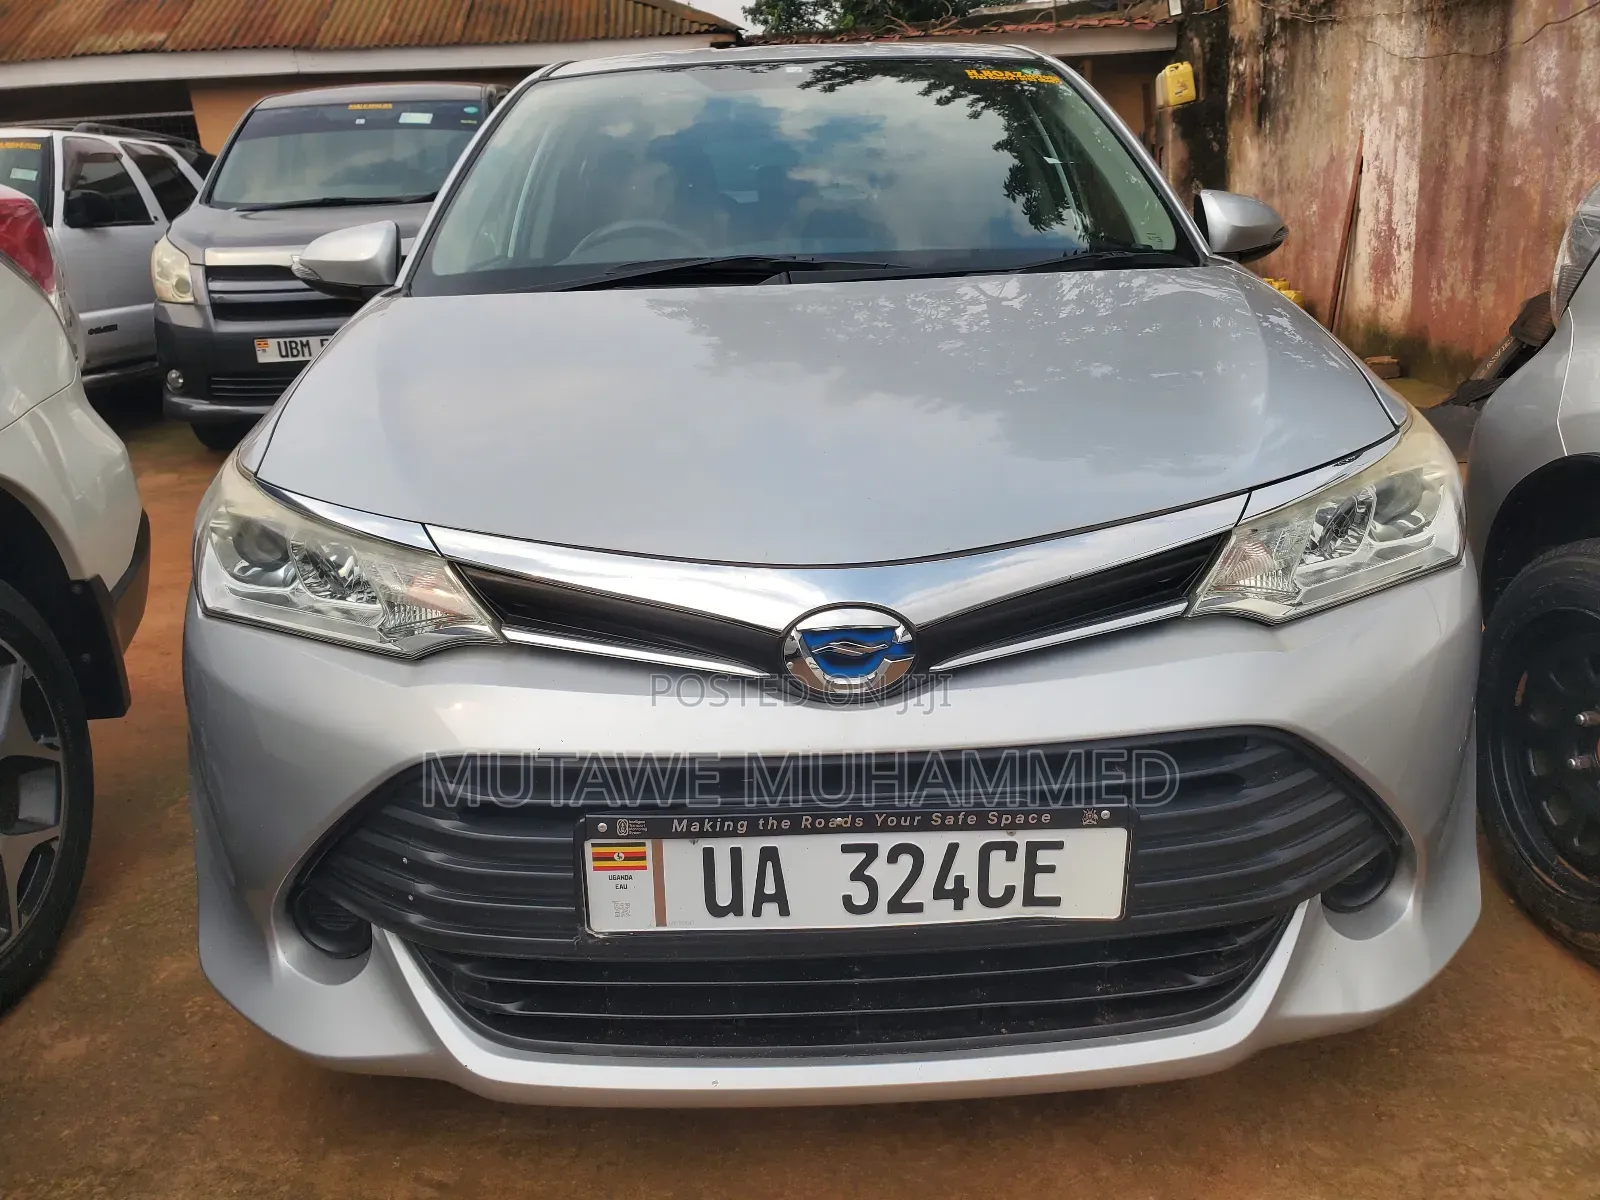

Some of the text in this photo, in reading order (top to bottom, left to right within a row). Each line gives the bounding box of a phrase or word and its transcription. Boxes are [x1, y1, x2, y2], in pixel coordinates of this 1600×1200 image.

[277, 340, 312, 358] UBM
[672, 811, 1051, 834] Making the Roads Your Safe Space
[702, 840, 1065, 918] UA 324CE
